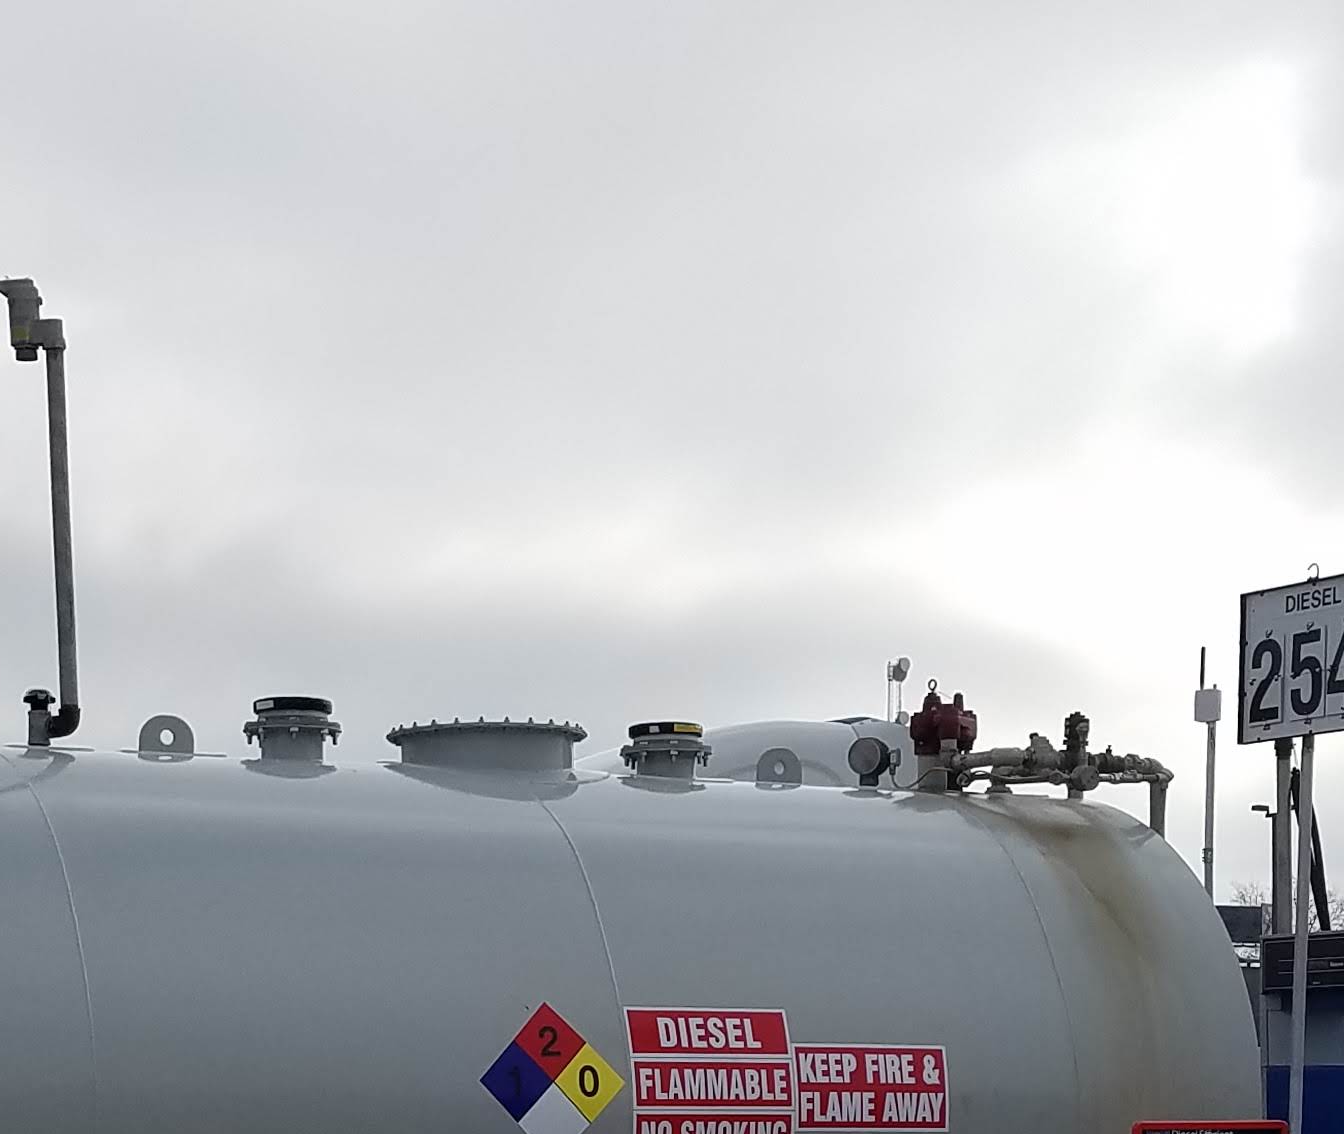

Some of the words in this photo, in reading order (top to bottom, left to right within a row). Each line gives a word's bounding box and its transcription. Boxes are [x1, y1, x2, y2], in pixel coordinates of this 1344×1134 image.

[1285, 587, 1342, 613] DIESEL
[538, 1026, 561, 1057] 2
[657, 1017, 762, 1048] DIESEL
[578, 1065, 600, 1098] 0
[799, 1053, 857, 1084] KEEP
[865, 1054, 914, 1084] FIRE
[922, 1055, 941, 1083] &
[639, 1068, 787, 1101] FLAMMABLE
[800, 1091, 875, 1122] FLAME
[882, 1092, 944, 1122] AWAY
